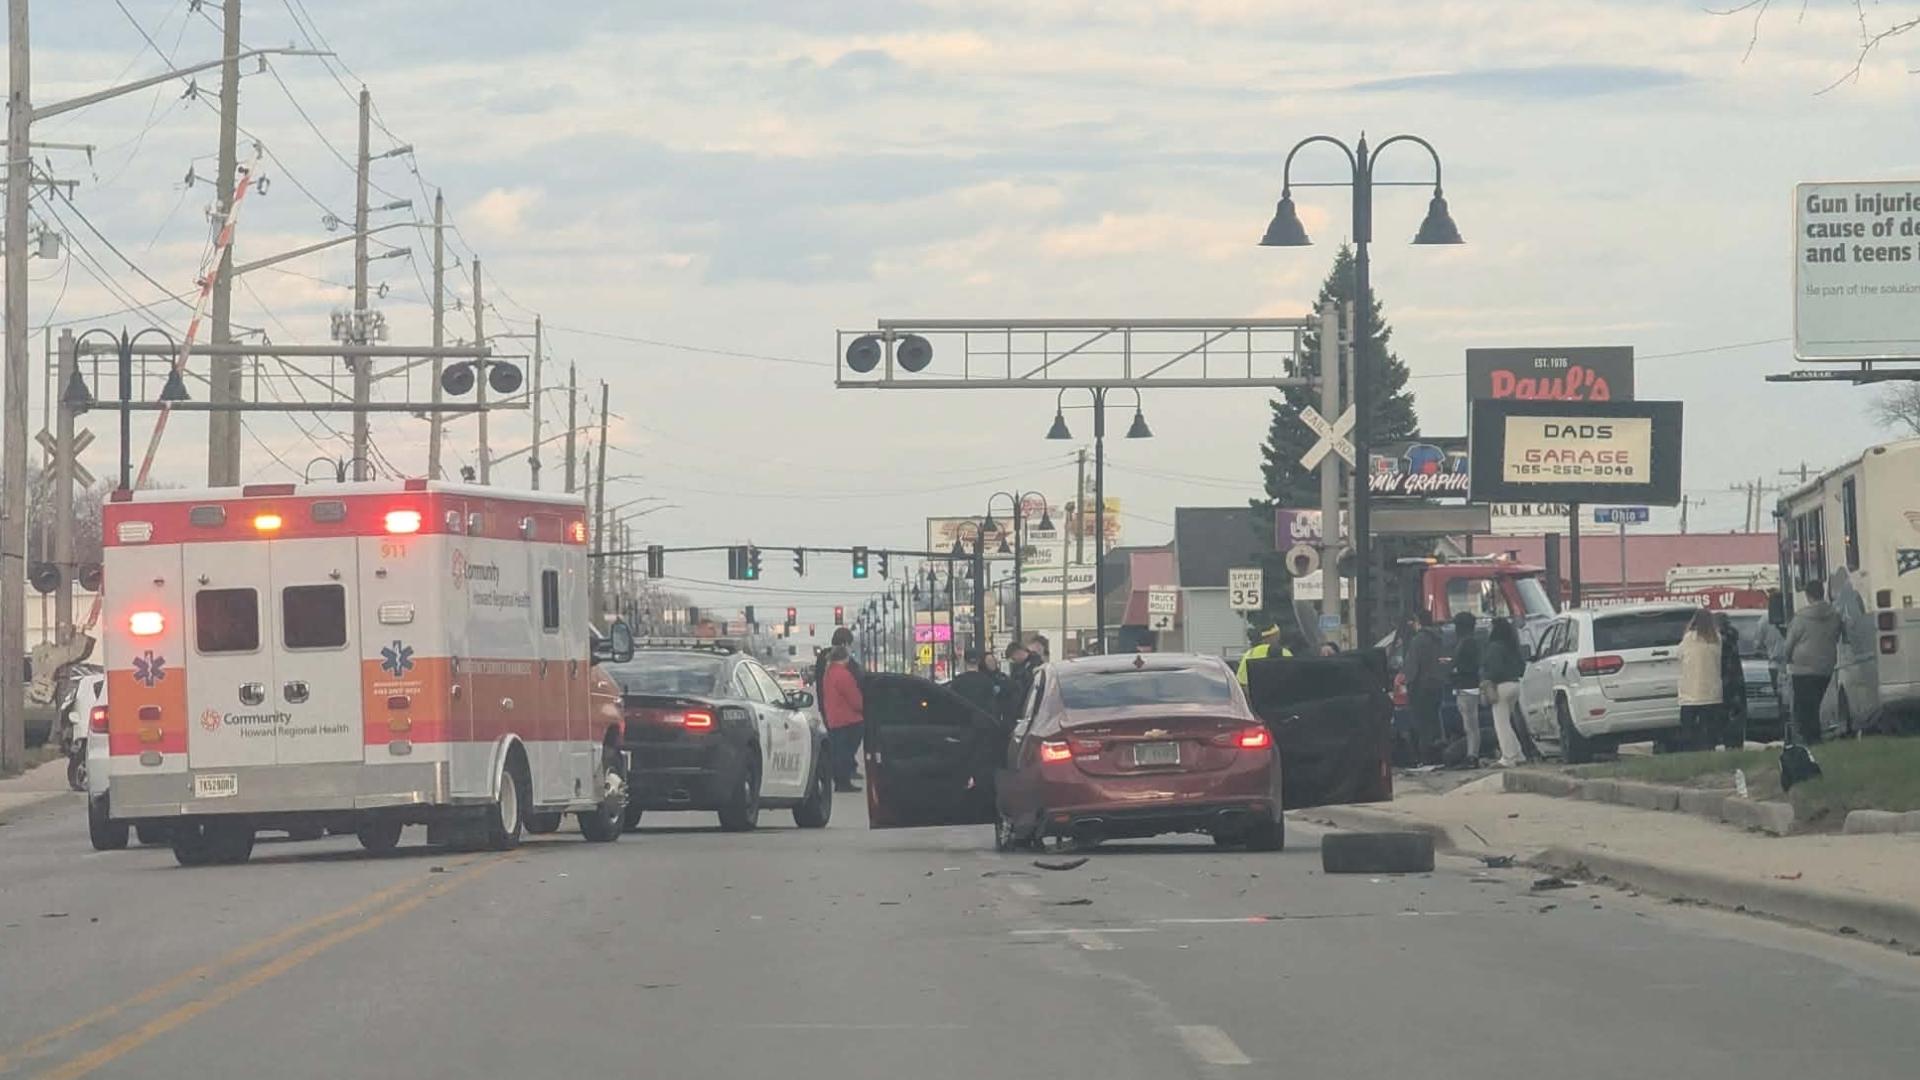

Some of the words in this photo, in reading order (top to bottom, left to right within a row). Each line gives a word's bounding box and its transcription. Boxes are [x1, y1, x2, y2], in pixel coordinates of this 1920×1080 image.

[1806, 194, 1848, 214] Gun
[1806, 222, 1865, 238] cause
[1872, 217, 1895, 237] of
[1900, 217, 1920, 237] de
[1806, 243, 1847, 263] and
[1852, 244, 1912, 262] teens
[1806, 285, 1820, 296] Be
[1822, 285, 1844, 297] part
[1848, 284, 1858, 294] of
[1861, 284, 1878, 294] the
[1534, 358, 1549, 368] EST.
[1490, 365, 1611, 400] Paul's
[1544, 424, 1614, 439] DADS
[1525, 449, 1629, 464] GARAGE
[1610, 508, 1637, 523] Ohio
[381, 543, 407, 558] 911
[463, 560, 500, 588] Community
[1150, 593, 1175, 602] TRUCK
[1232, 589, 1259, 605] 35
[1150, 602, 1175, 611] ROUTE
[223, 711, 292, 726] Community
[240, 727, 277, 738] Howard
[278, 726, 318, 738] Regional
[319, 724, 349, 734] Health
[772, 751, 802, 772] POLICE
